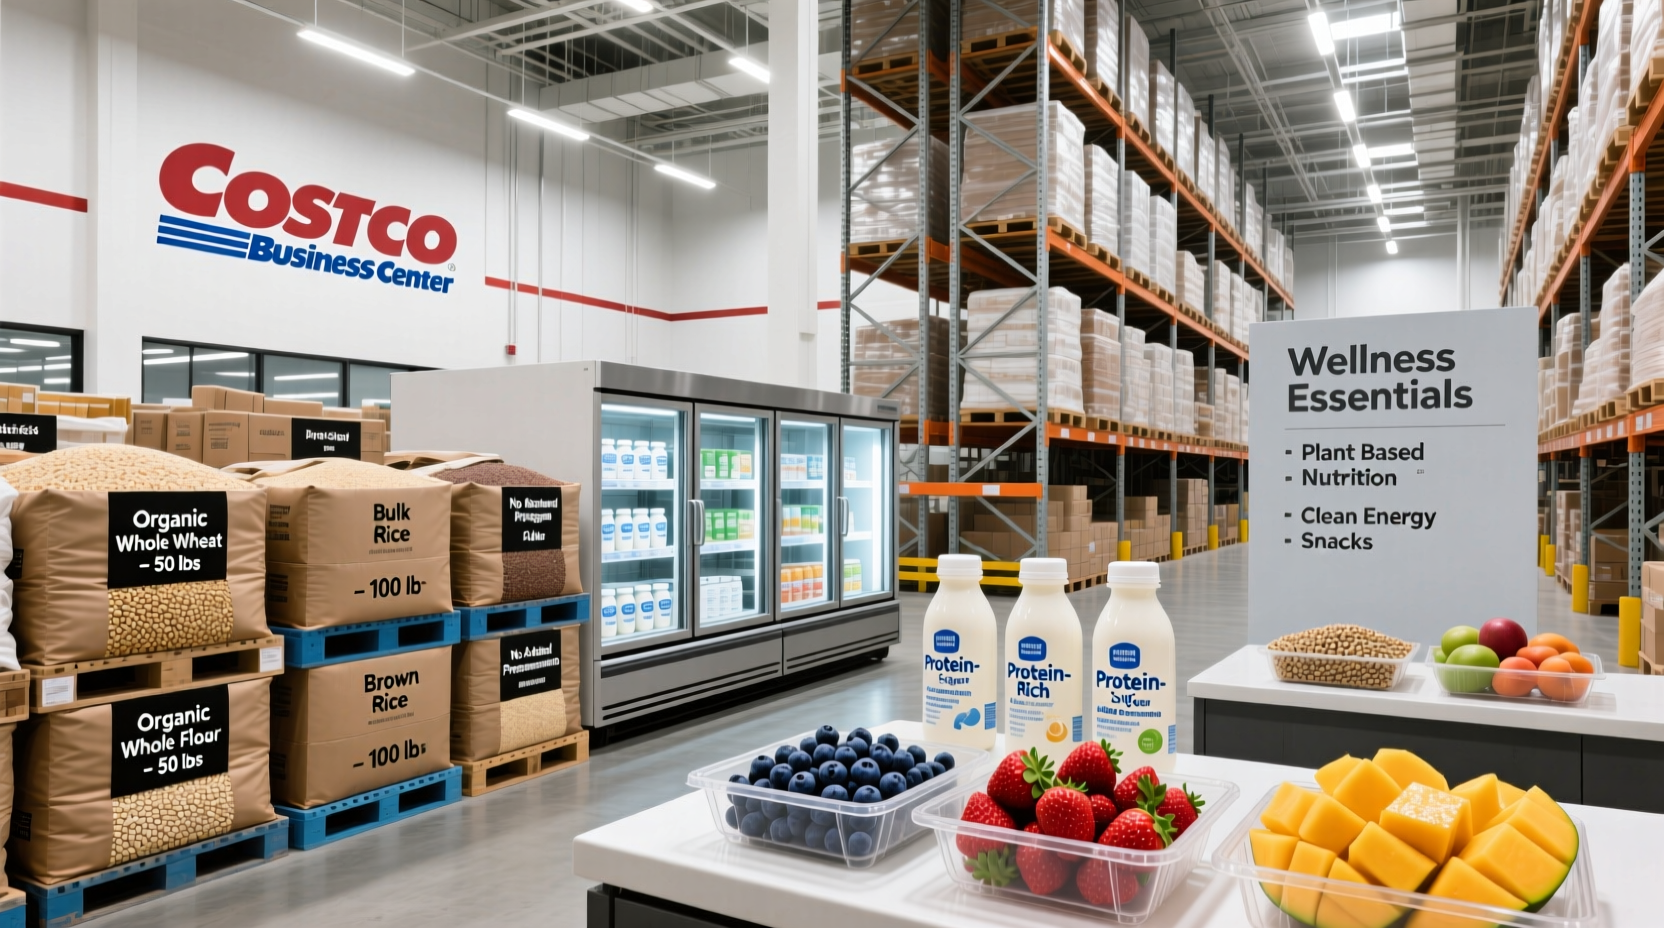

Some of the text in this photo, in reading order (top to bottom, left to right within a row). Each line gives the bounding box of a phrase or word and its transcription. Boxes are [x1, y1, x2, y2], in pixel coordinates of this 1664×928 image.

[159, 143, 456, 264] COSTCO
[247, 233, 454, 293] Business Center
[1288, 344, 1455, 376] Wellness
[1289, 379, 1472, 412] Essentials
[1303, 442, 1423, 460] Plant Based
[1303, 468, 1396, 486] Nutrition
[133, 509, 207, 532] Organic
[374, 503, 410, 521] Bulk
[1302, 507, 1436, 529] Clean Energy
[116, 532, 222, 552] Whole Wheat
[374, 526, 410, 543] Rice
[1302, 532, 1373, 549] Snacks
[155, 556, 174, 572] 50
[179, 555, 200, 570] lbs
[370, 577, 401, 598] 100
[925, 654, 980, 673] Protein-
[1008, 662, 1071, 681] Protein-
[364, 670, 419, 693] Brown
[1017, 681, 1050, 698] Rich
[1097, 670, 1166, 690] Protein-
[373, 693, 408, 713] Rice
[137, 704, 210, 732] Organic
[121, 728, 221, 758] Whole Flour
[158, 755, 178, 774] 50
[182, 753, 203, 769] lbs
[369, 744, 399, 768] 100
